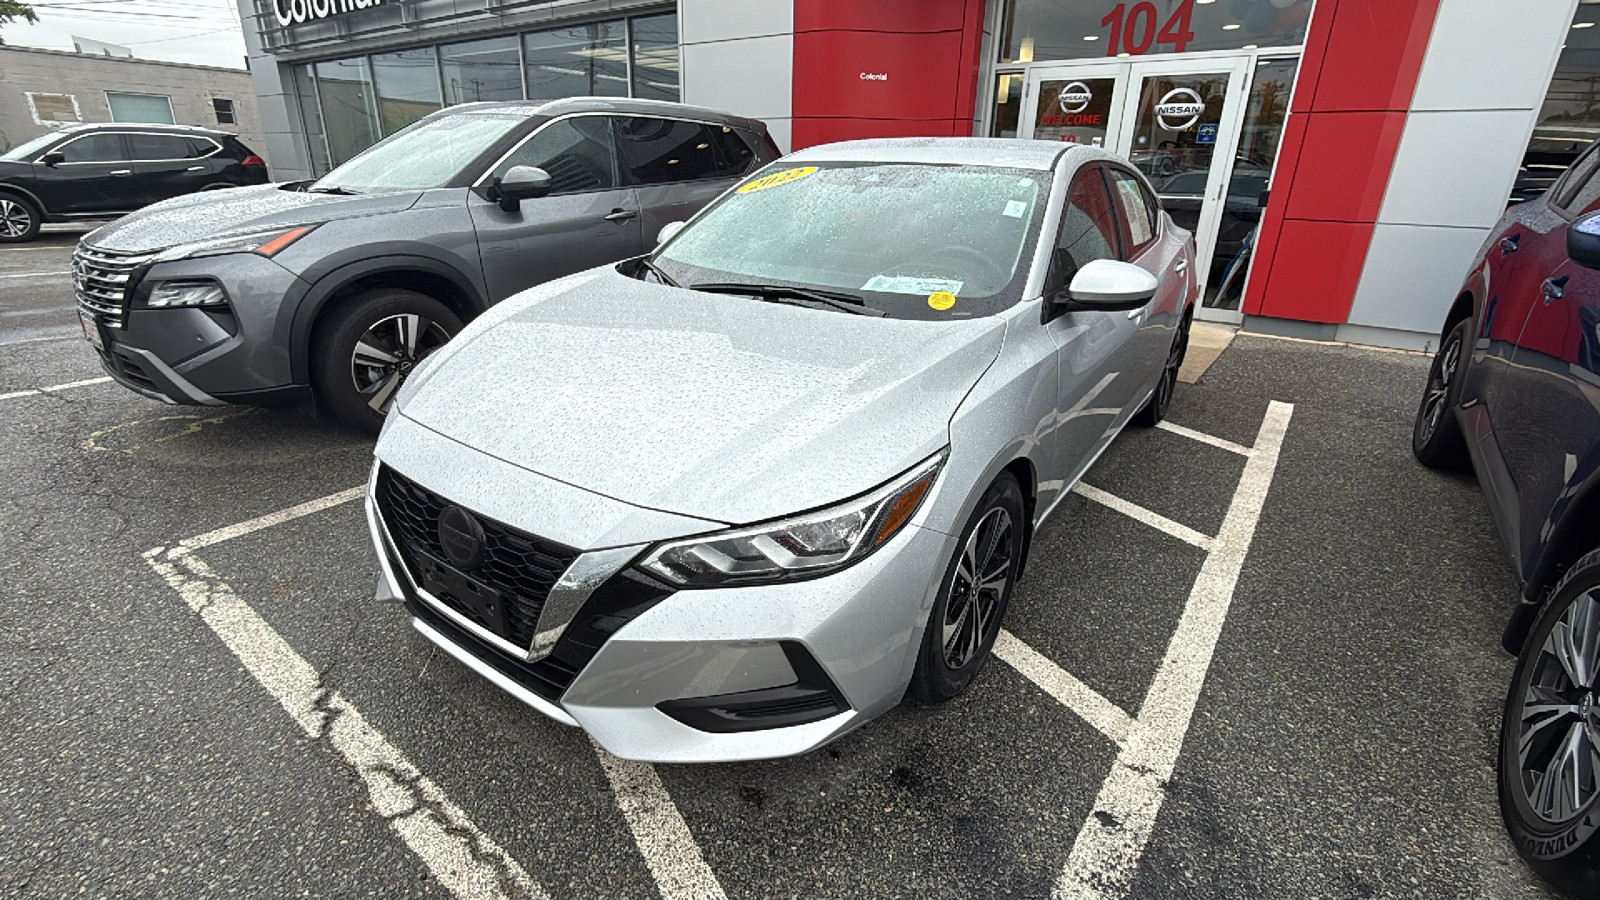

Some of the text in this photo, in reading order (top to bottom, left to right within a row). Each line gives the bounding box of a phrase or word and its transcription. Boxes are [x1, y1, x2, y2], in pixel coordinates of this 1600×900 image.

[273, 0, 381, 26] Colon
[1101, 0, 1195, 57] 104
[859, 71, 888, 81] Colonial
[1157, 106, 1201, 114] NISSAN
[1041, 114, 1101, 126] WELCOME
[1059, 134, 1076, 143] TO
[1522, 827, 1579, 856] DUNLO
